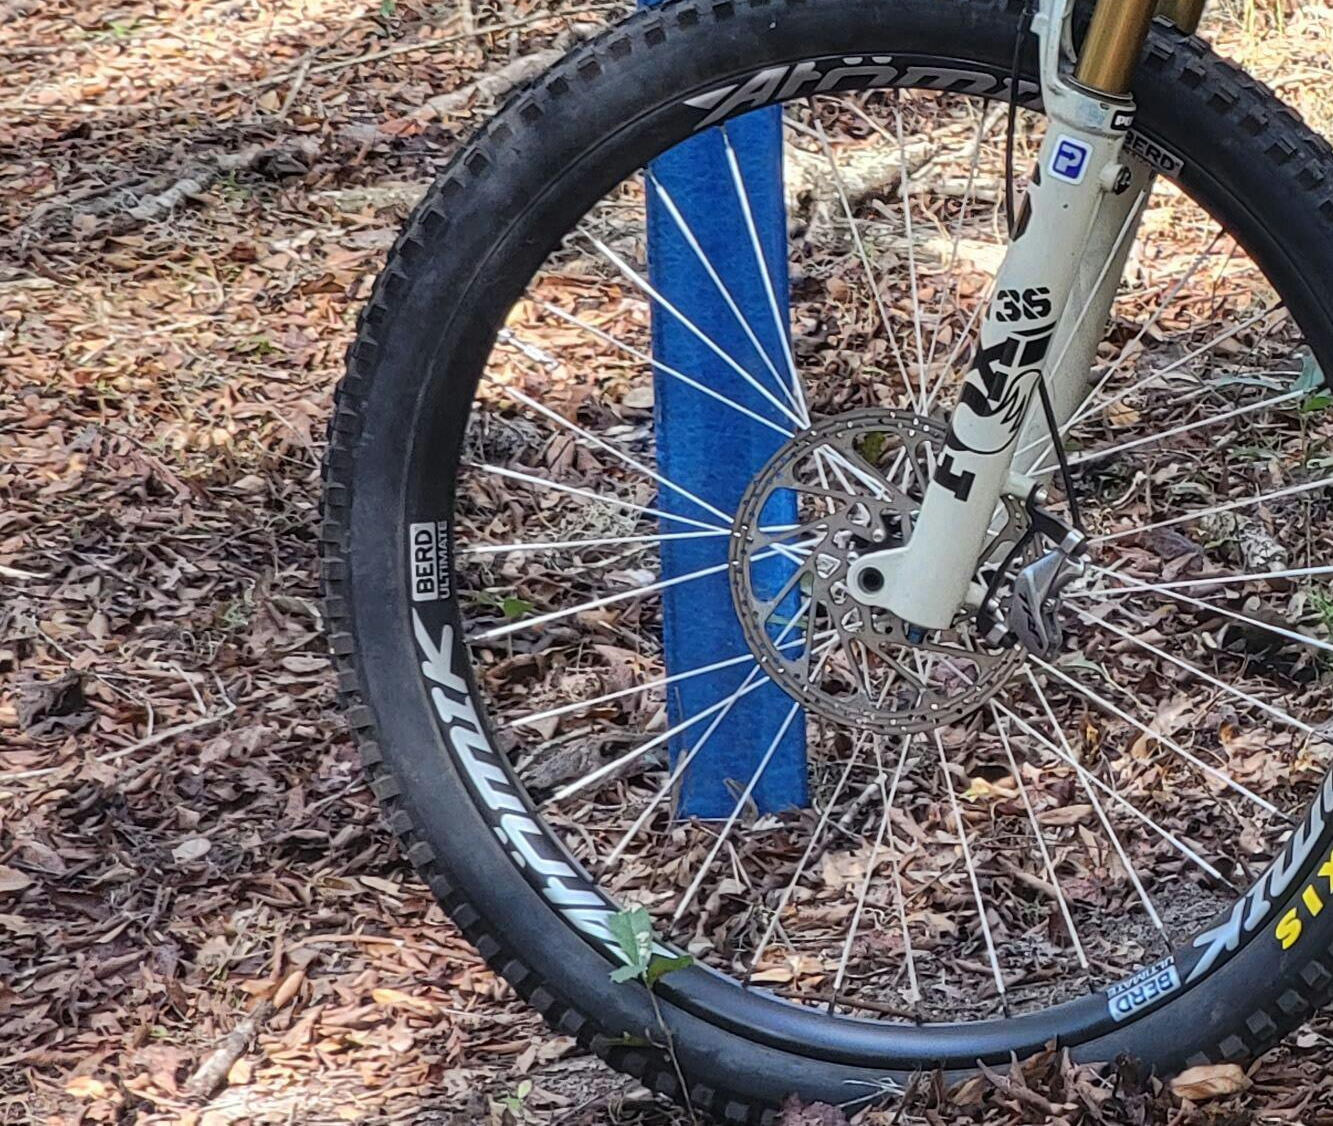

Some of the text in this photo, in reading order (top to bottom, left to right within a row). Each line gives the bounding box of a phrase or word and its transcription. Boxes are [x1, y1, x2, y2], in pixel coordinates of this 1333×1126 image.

[414, 529, 435, 594] BERD
[437, 520, 451, 600] ULTIMATE
[1106, 955, 1175, 999] ULTIMATE
[1116, 971, 1175, 1014] BERD
